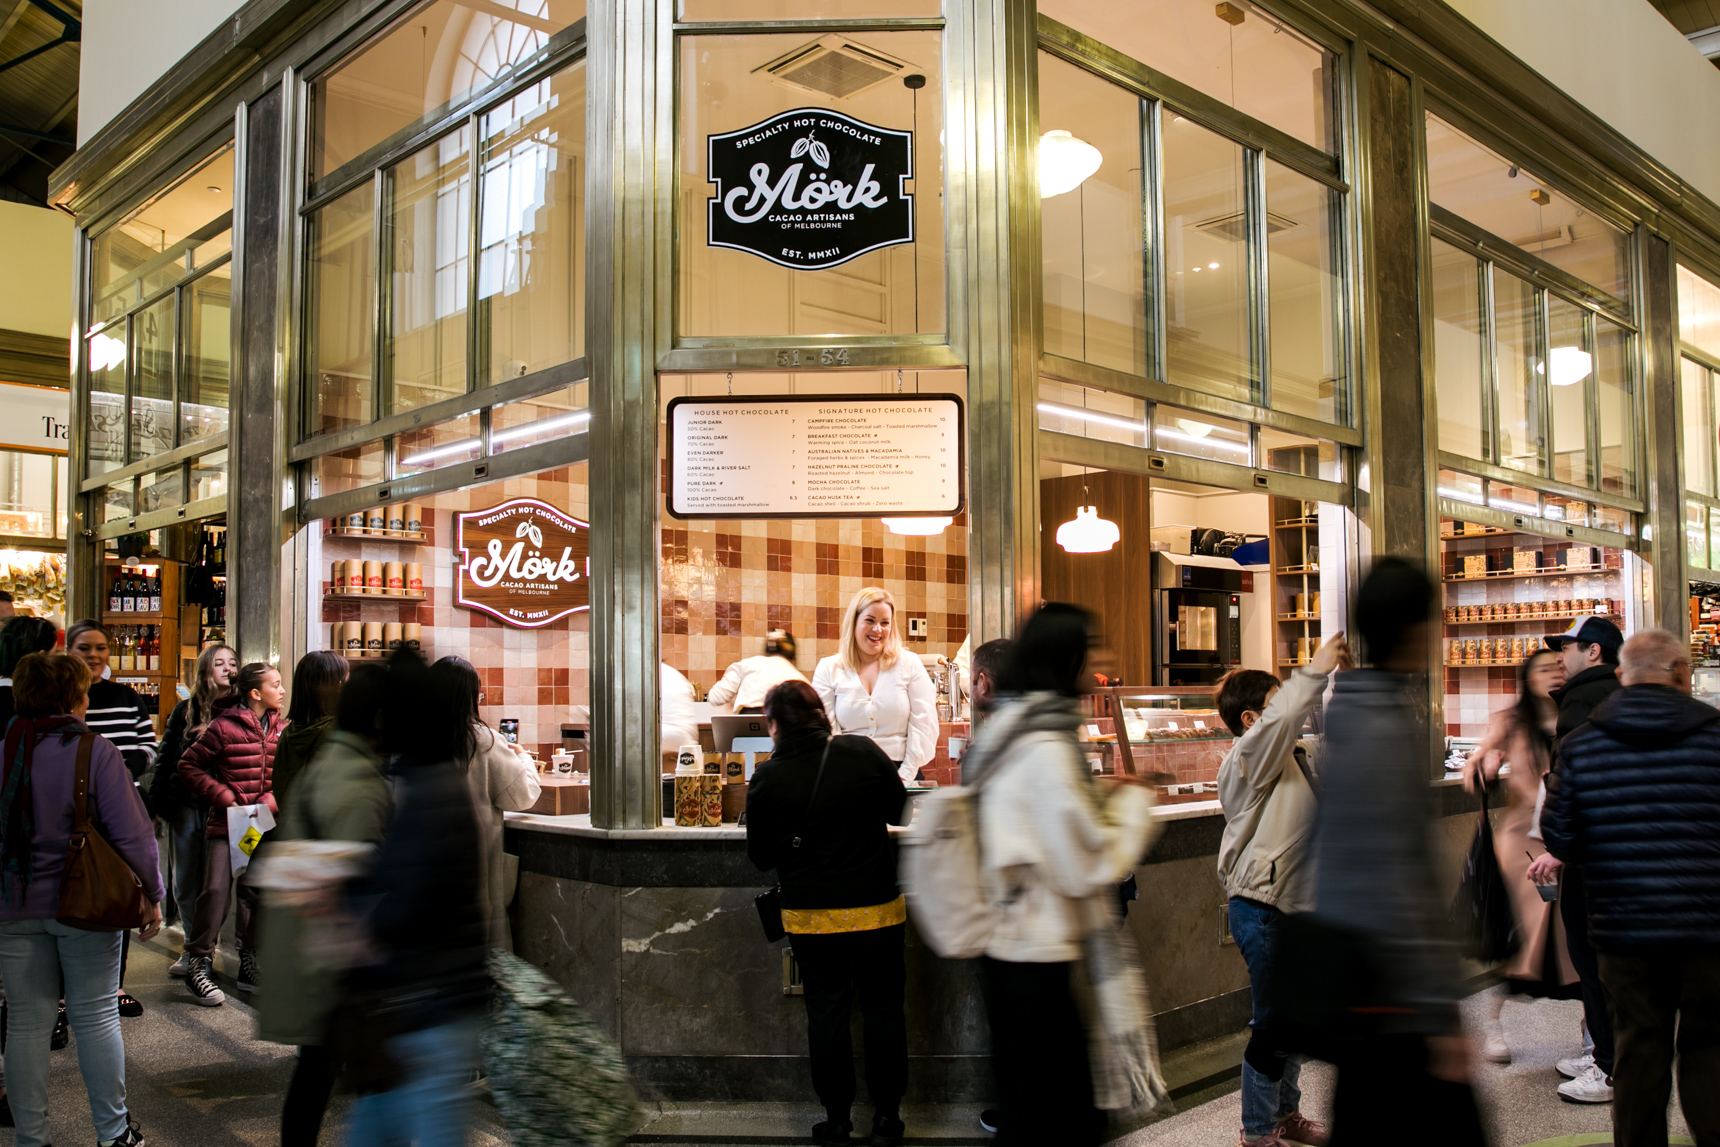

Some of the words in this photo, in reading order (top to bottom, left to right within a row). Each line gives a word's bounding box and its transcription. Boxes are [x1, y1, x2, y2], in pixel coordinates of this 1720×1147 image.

[736, 122, 790, 149] SPECIALTY
[793, 118, 816, 128] HOT
[820, 119, 882, 145] CHOCOLATE
[724, 162, 888, 224] Mörk
[768, 214, 802, 222] CACAO
[806, 213, 855, 221] ARTISANS
[781, 248, 803, 259] EST.
[808, 247, 840, 259] MMXII
[478, 508, 516, 526] SPECIALTY
[535, 509, 577, 533] CHOCOLATE
[469, 539, 580, 588] Mörk
[526, 582, 558, 590] ARTISANS
[509, 608, 524, 618] EST.
[526, 609, 549, 619] MMXII
